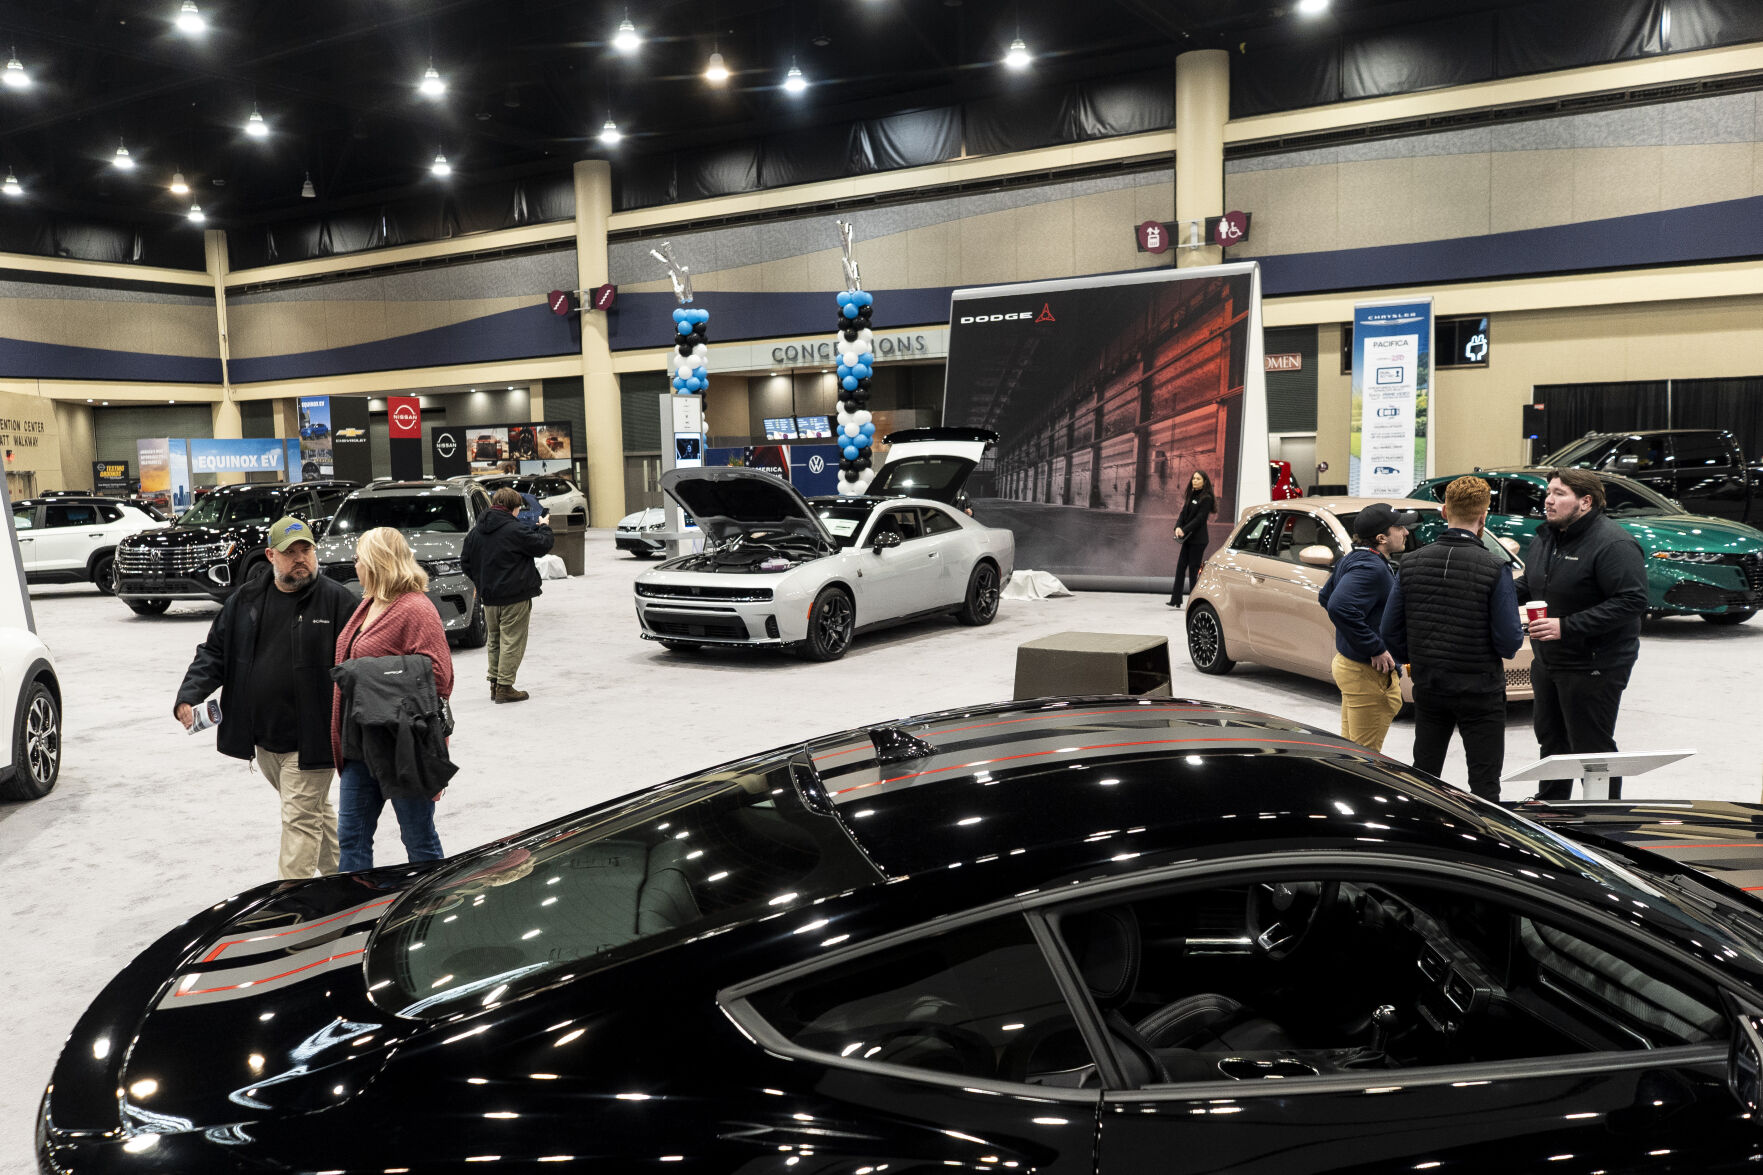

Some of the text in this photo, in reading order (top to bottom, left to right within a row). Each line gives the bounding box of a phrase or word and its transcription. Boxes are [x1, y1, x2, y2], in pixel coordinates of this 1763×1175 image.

[960, 311, 1033, 324] DODGE
[1367, 312, 1416, 320] CHRYSLER
[771, 335, 926, 363] CONCIONS
[1373, 339, 1409, 348] PACIFICA
[1264, 355, 1300, 369] OMEN
[24, 420, 45, 433] CENTER
[13, 435, 39, 447] WALKWAY
[198, 455, 278, 471] EQUINOX EV
